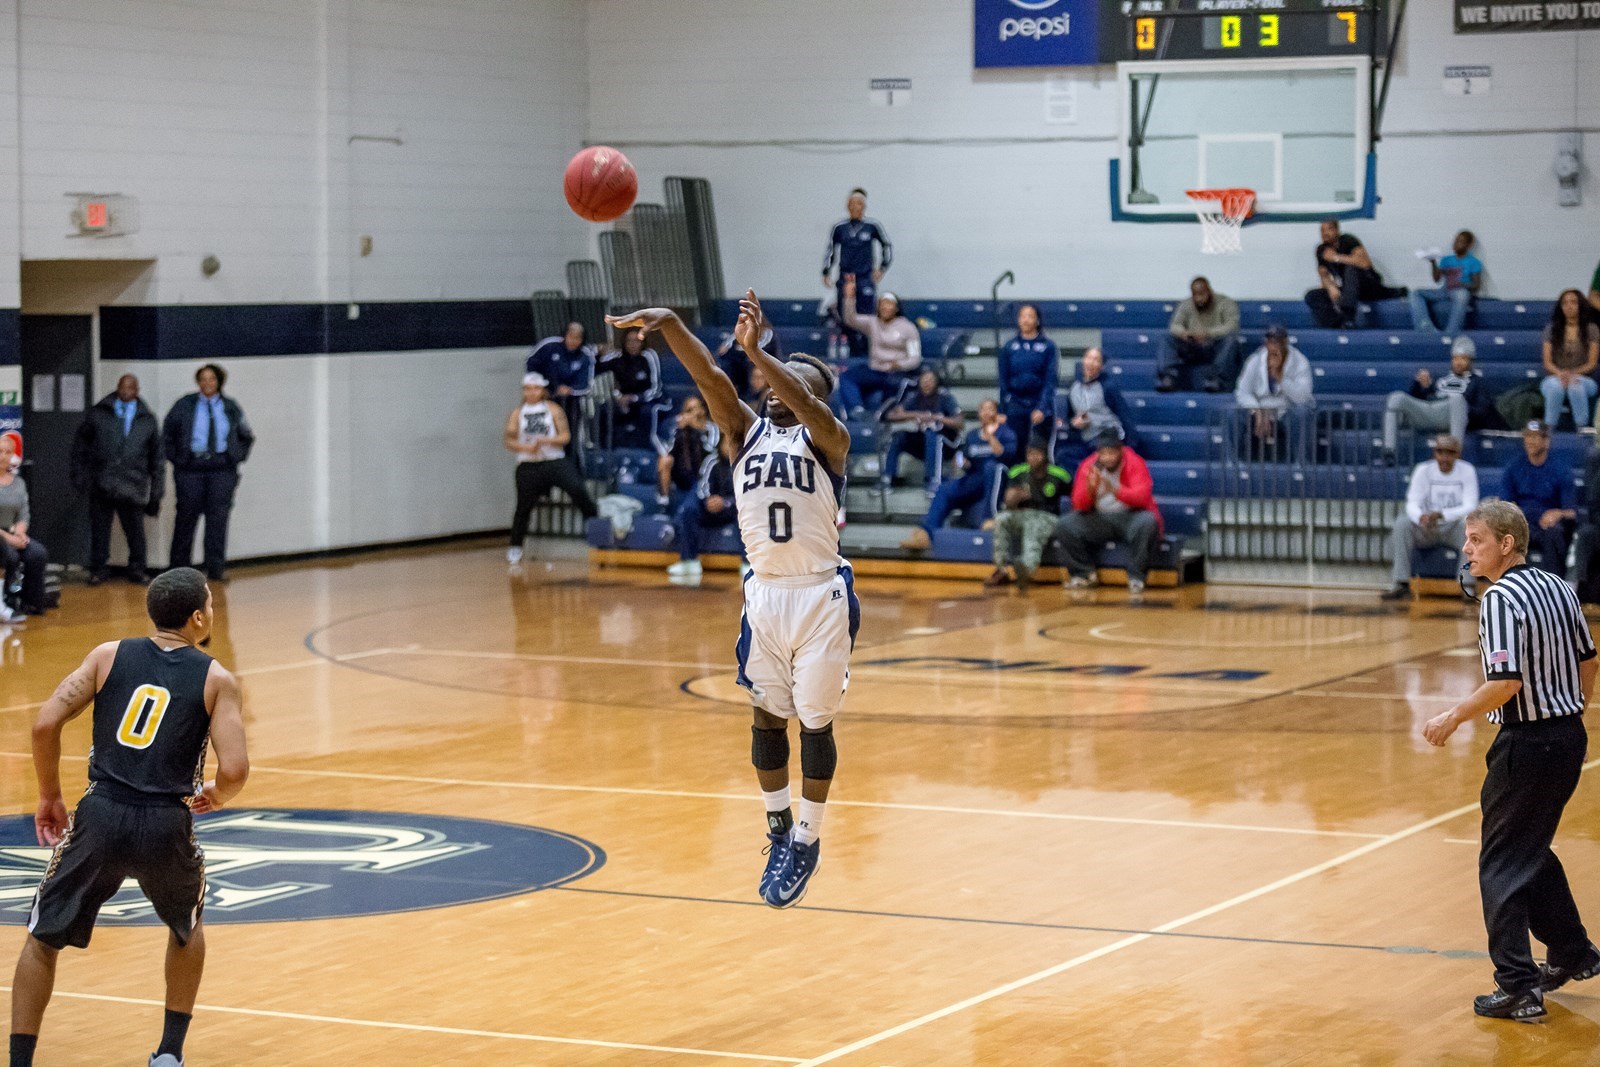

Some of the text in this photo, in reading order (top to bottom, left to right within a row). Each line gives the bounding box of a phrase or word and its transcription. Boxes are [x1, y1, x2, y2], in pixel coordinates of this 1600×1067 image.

[999, 12, 1070, 42] pepsi
[1337, 11, 1357, 44] 7
[1461, 6, 1488, 24] WE
[1490, 4, 1543, 23] INVITE
[1545, 3, 1579, 20] YOU
[1259, 14, 1279, 47] 3
[743, 451, 816, 495] SAU
[769, 501, 793, 544] 0
[116, 683, 171, 750] 0
